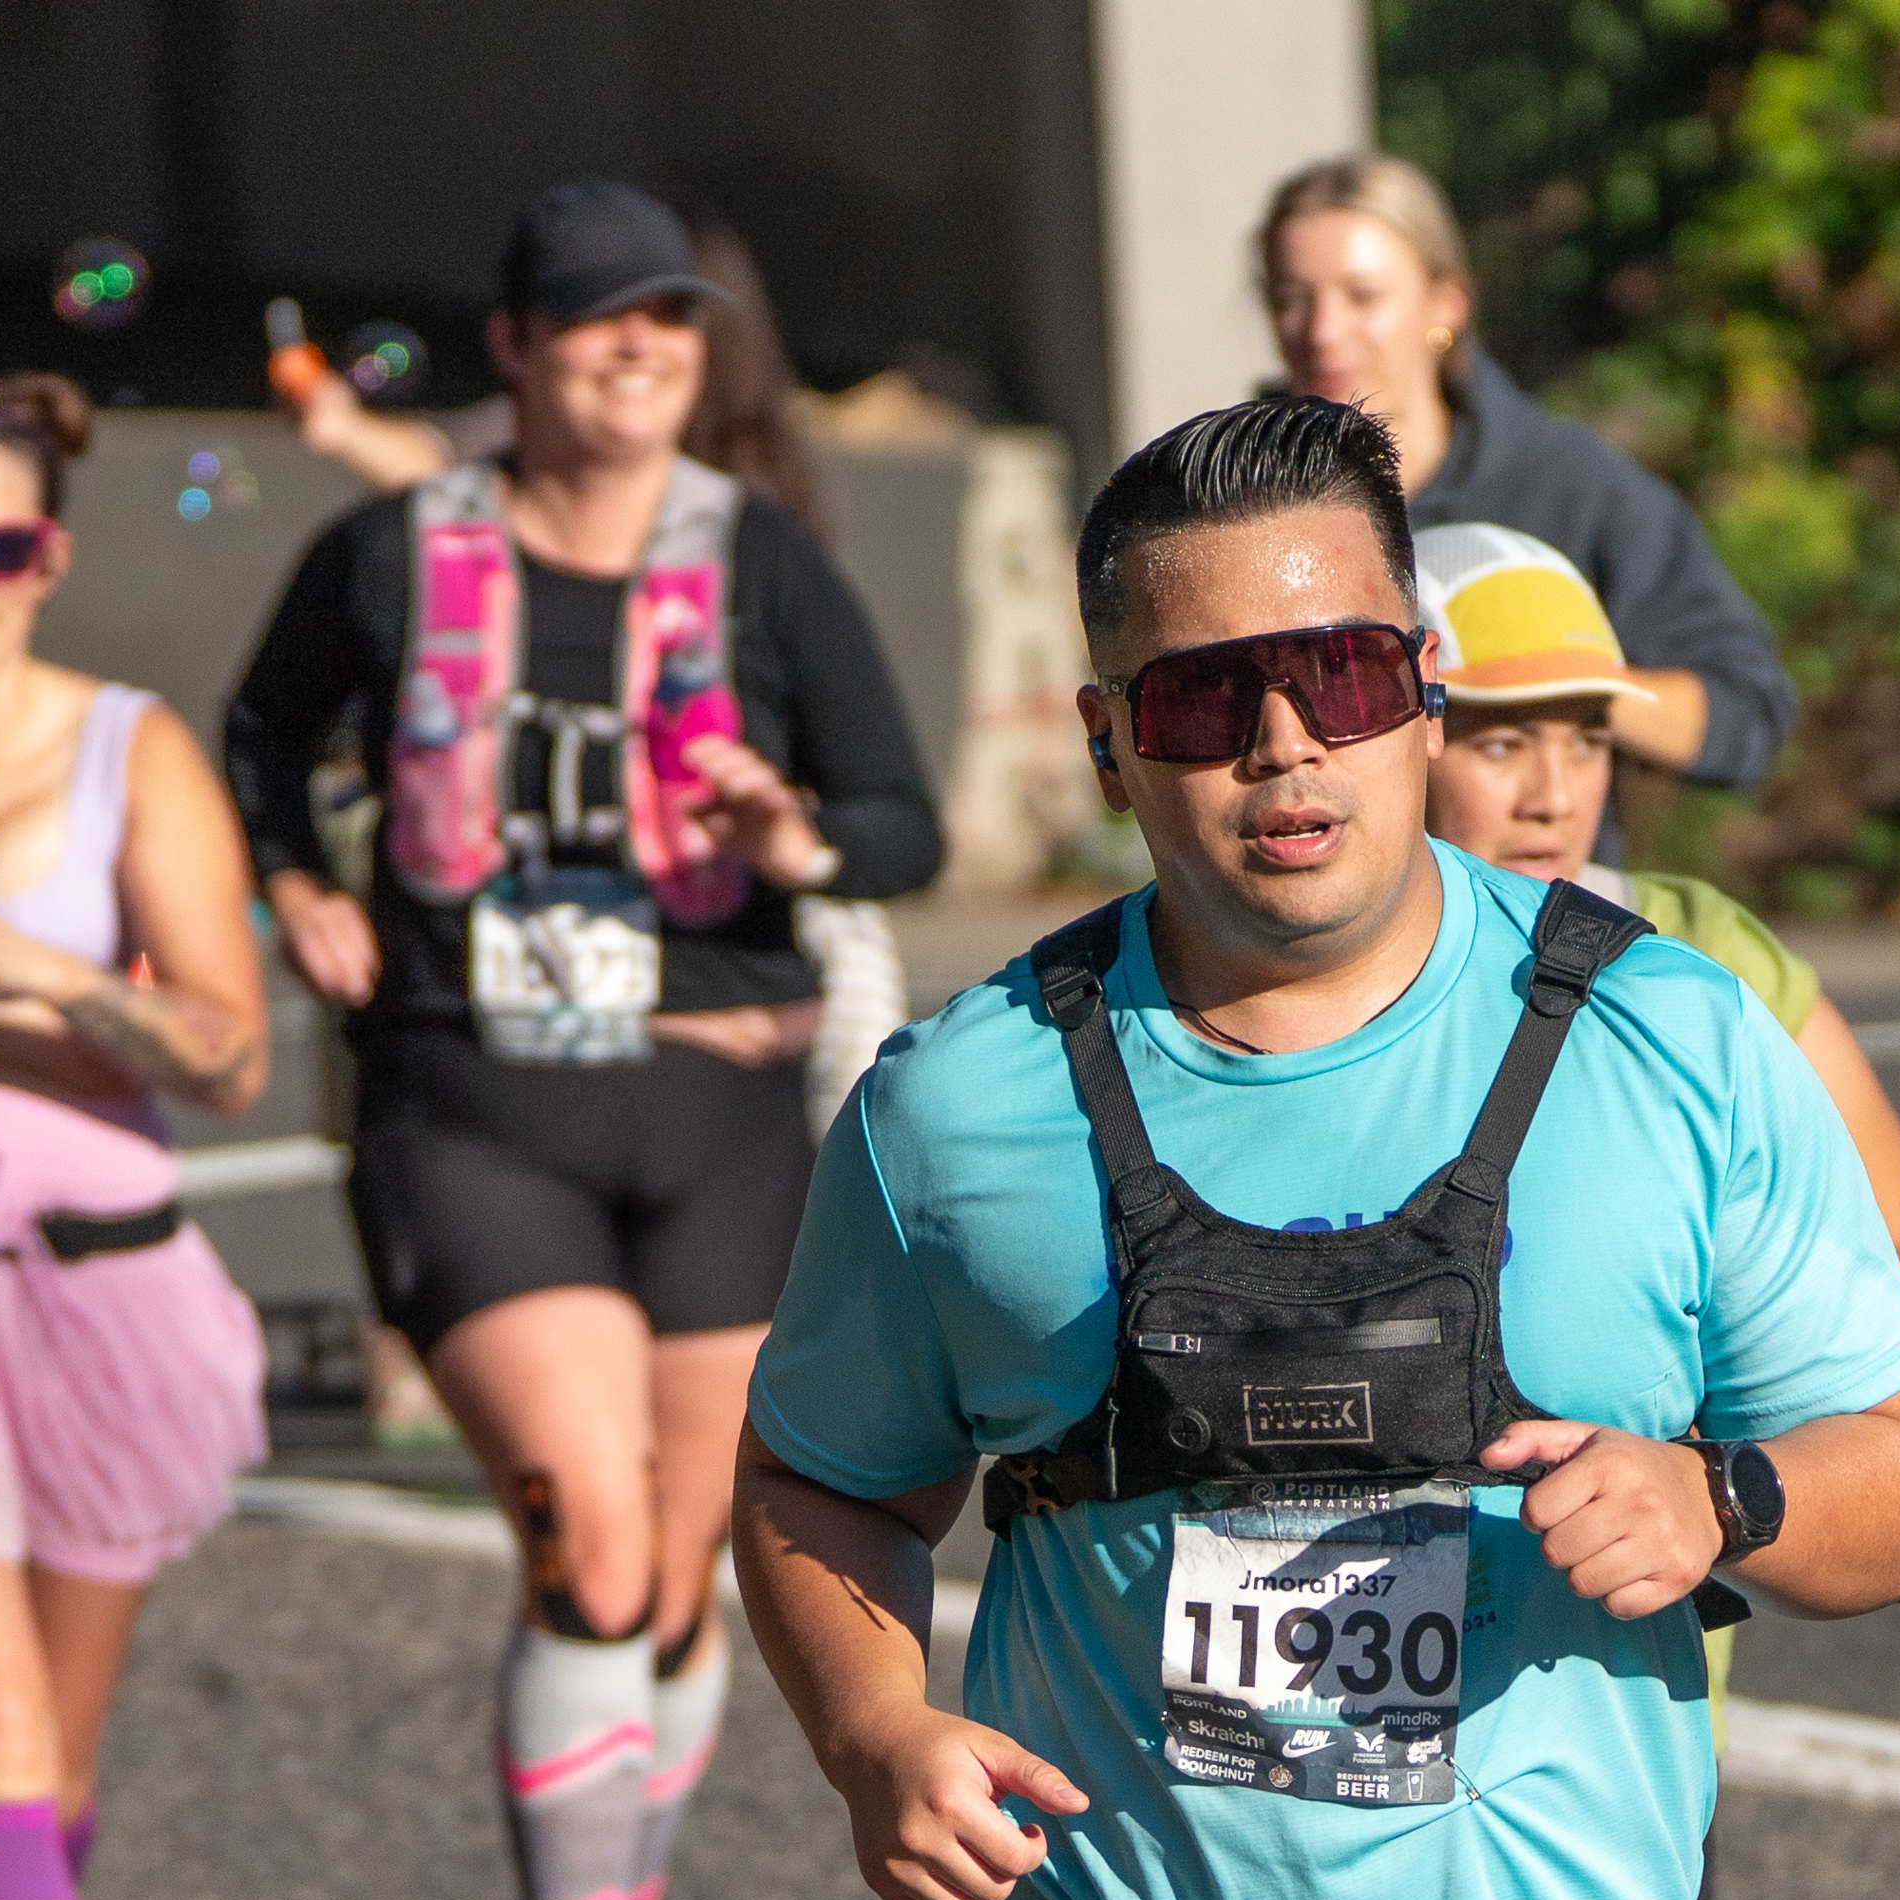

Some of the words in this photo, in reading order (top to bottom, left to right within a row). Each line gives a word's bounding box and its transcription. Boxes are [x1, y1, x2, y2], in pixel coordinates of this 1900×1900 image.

[1284, 1482, 1390, 1501] PORTLAND
[1284, 1499, 1391, 1510] MARATHON
[1238, 1569, 1398, 1598] Jmora1337
[1462, 1610, 1497, 1633] 024
[1184, 1600, 1458, 1698] 11930
[1173, 1698, 1247, 1720] PORTLAND
[1290, 1729, 1331, 1748] RUN
[1180, 1744, 1229, 1766] REDEEM
[1231, 1754, 1256, 1770] FOR
[1177, 1757, 1256, 1784] DOUGHNUT
[1336, 1772, 1371, 1782] REDEEM
[1372, 1774, 1390, 1783] FOR
[1336, 1781, 1390, 1799] BEER
